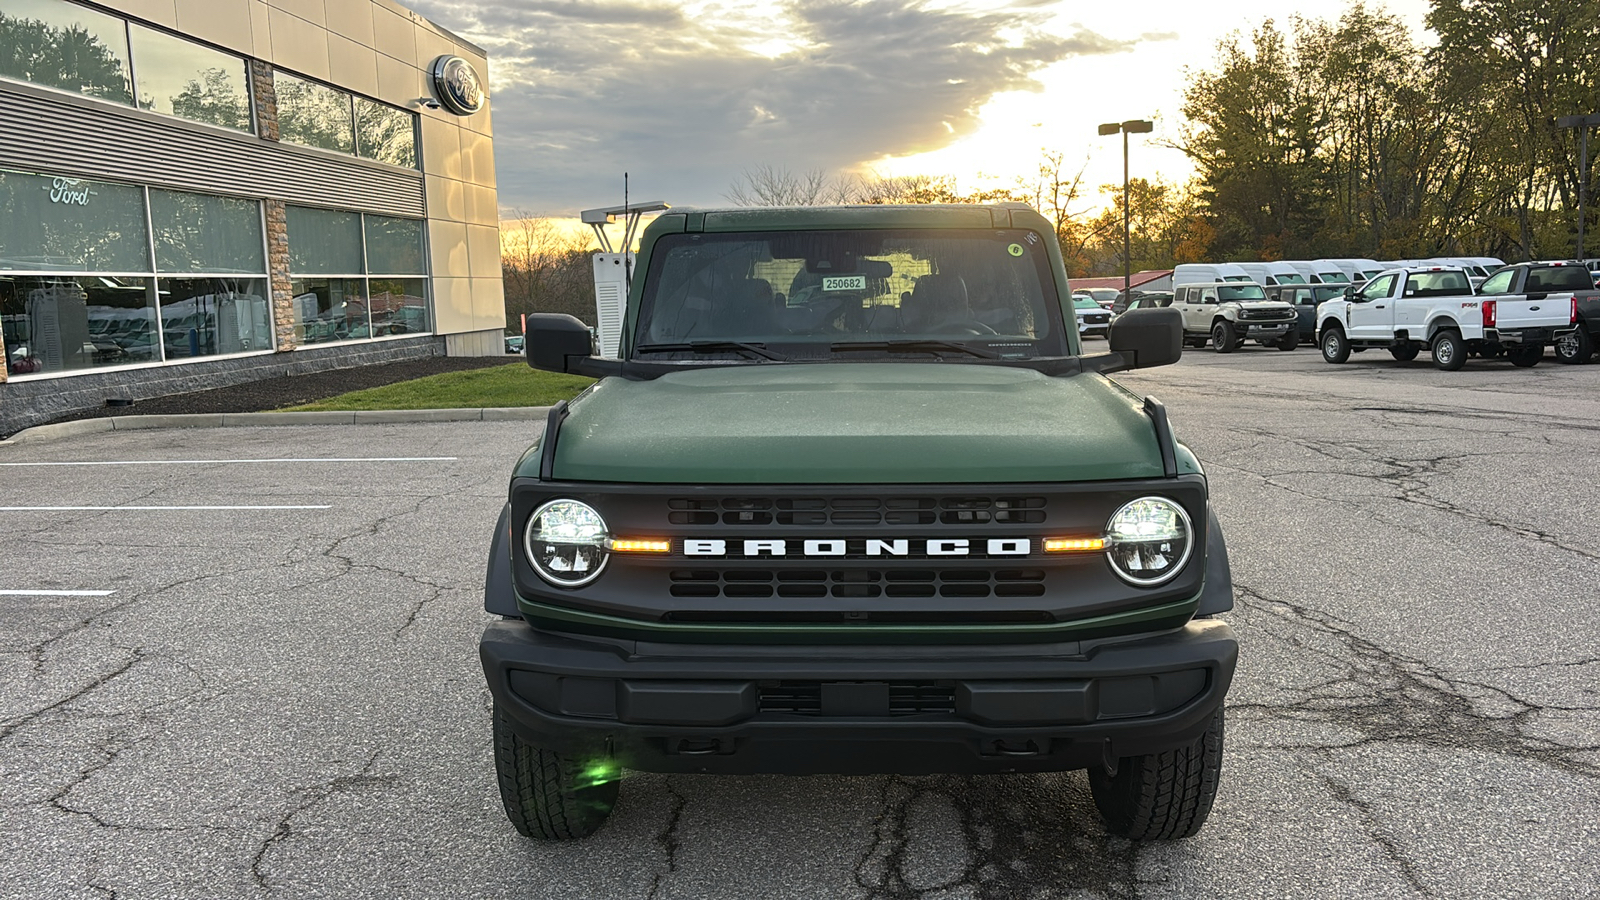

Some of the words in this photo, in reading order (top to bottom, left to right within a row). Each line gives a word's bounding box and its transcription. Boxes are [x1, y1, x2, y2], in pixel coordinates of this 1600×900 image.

[456, 67, 479, 103] Ford
[50, 177, 89, 205] Ford
[826, 278, 861, 289] 250682
[683, 539, 1031, 556] BRONCO
